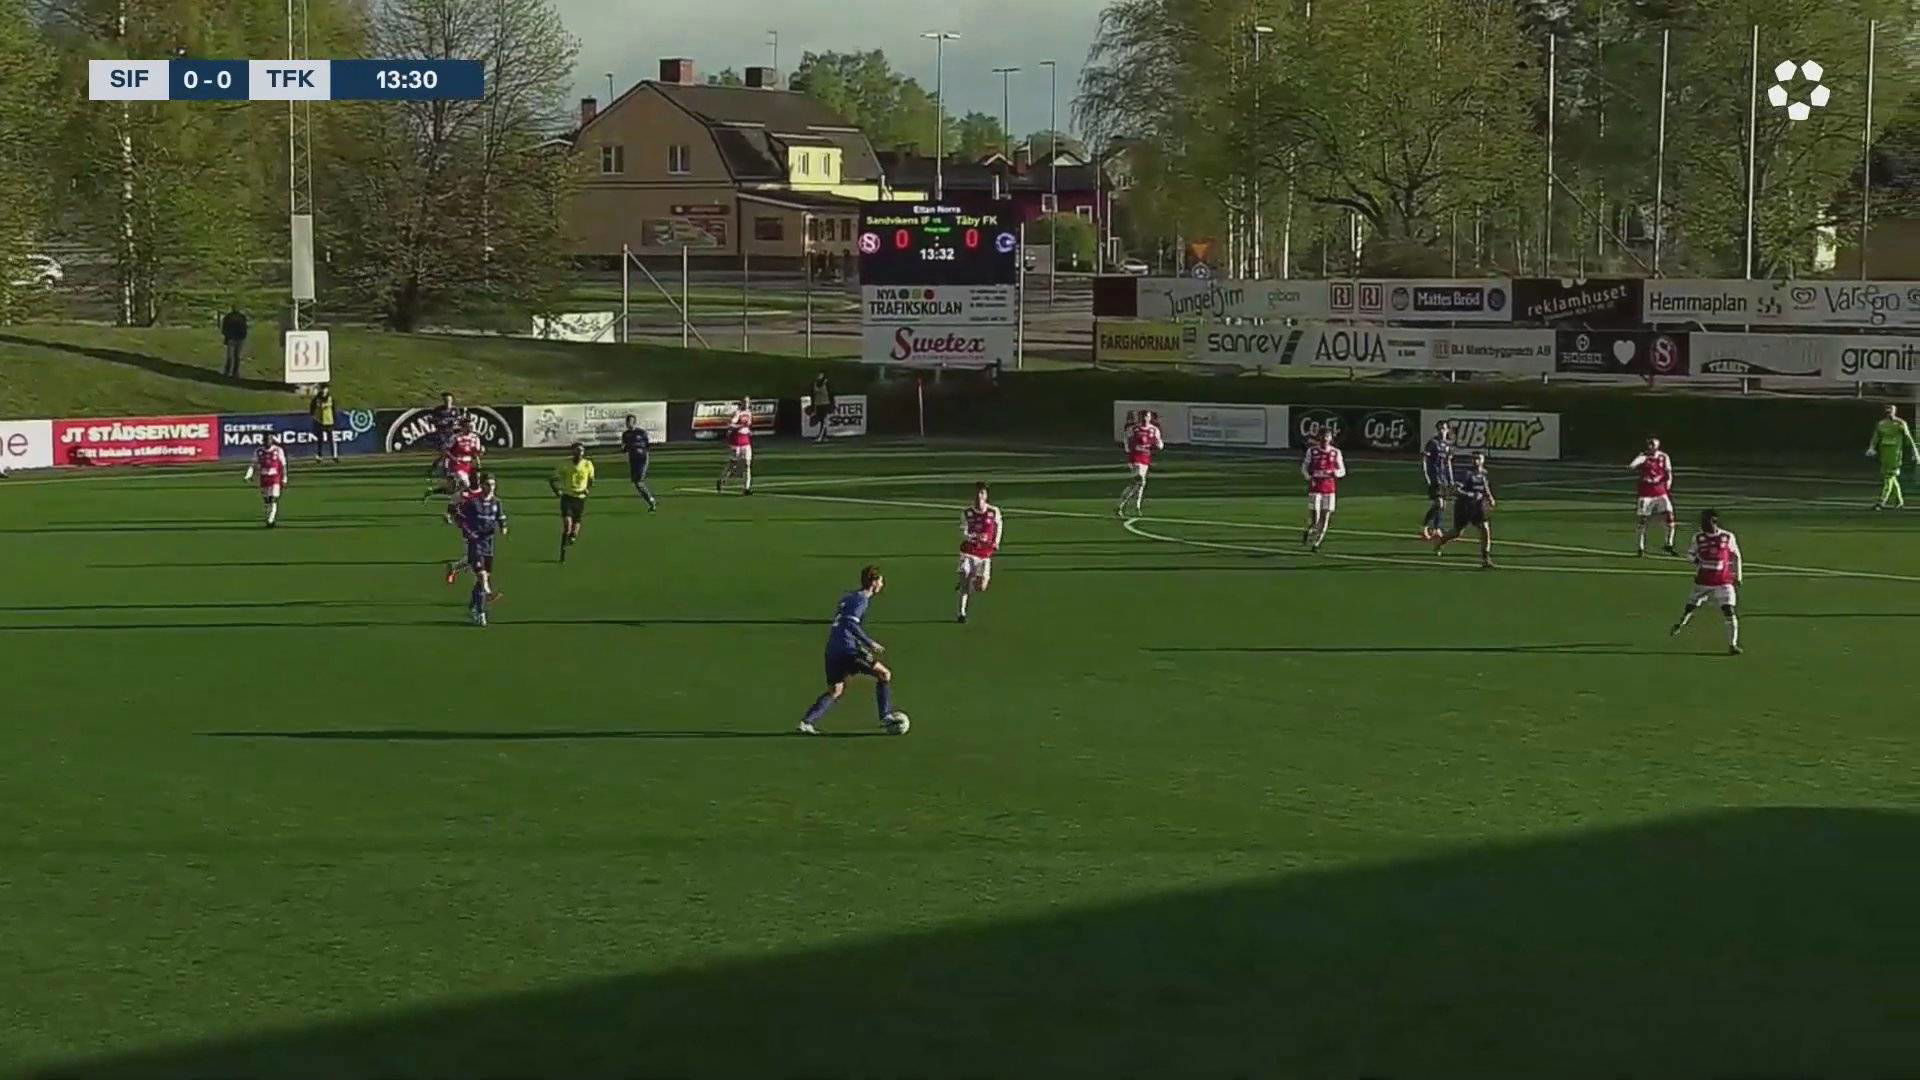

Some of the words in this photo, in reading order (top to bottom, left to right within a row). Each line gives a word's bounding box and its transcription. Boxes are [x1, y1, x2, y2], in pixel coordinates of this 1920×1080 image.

[982, 216, 998, 225] FK
[920, 248, 955, 260] 13:32
[876, 289, 897, 300] NYA
[1527, 285, 1628, 317] reklamhuset
[869, 301, 963, 316] TRAFIKSKOLAN
[1650, 291, 1747, 316] Hemmaplan
[890, 327, 986, 361] Swetex
[1315, 331, 1387, 363] AQUA
[829, 415, 863, 427] SPORT
[61, 427, 86, 443] JT
